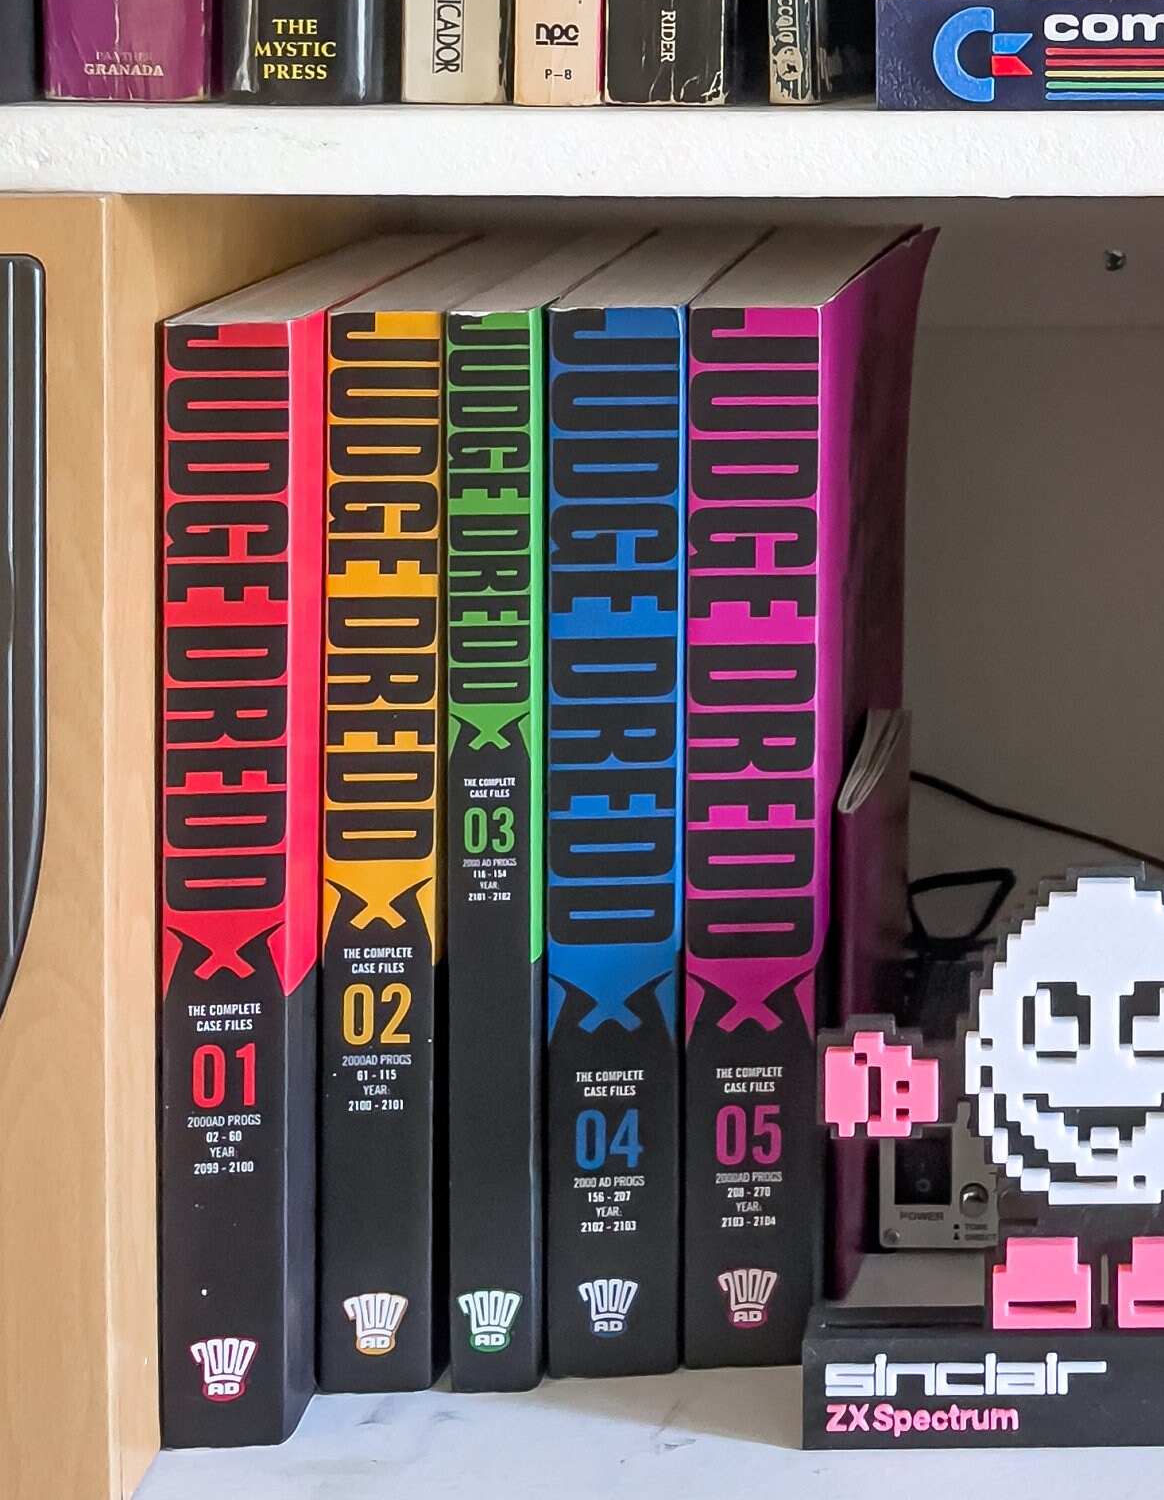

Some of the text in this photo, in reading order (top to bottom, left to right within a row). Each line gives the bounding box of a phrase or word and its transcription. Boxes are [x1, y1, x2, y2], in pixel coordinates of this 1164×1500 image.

[272, 18, 318, 36] THE
[661, 9, 676, 63] RIDER
[255, 41, 336, 58] MYSTIC
[83, 63, 164, 77] GRANADA
[263, 63, 328, 80] PRESS
[463, 806, 515, 854] 03
[188, 1002, 262, 1016] THE COMPLETE
[342, 983, 411, 1045] 02
[196, 1018, 253, 1032] CASE FILES
[191, 1042, 256, 1109] 01
[227, 1114, 261, 1127] PROGS
[575, 1108, 643, 1171] 04
[715, 1105, 782, 1166] 05
[193, 1161, 254, 1174] 2099 2100
[825, 1353, 1107, 1397] sinclair
[208, 1382, 240, 1396] AD
[826, 1404, 1019, 1437] ZX Spectrum
